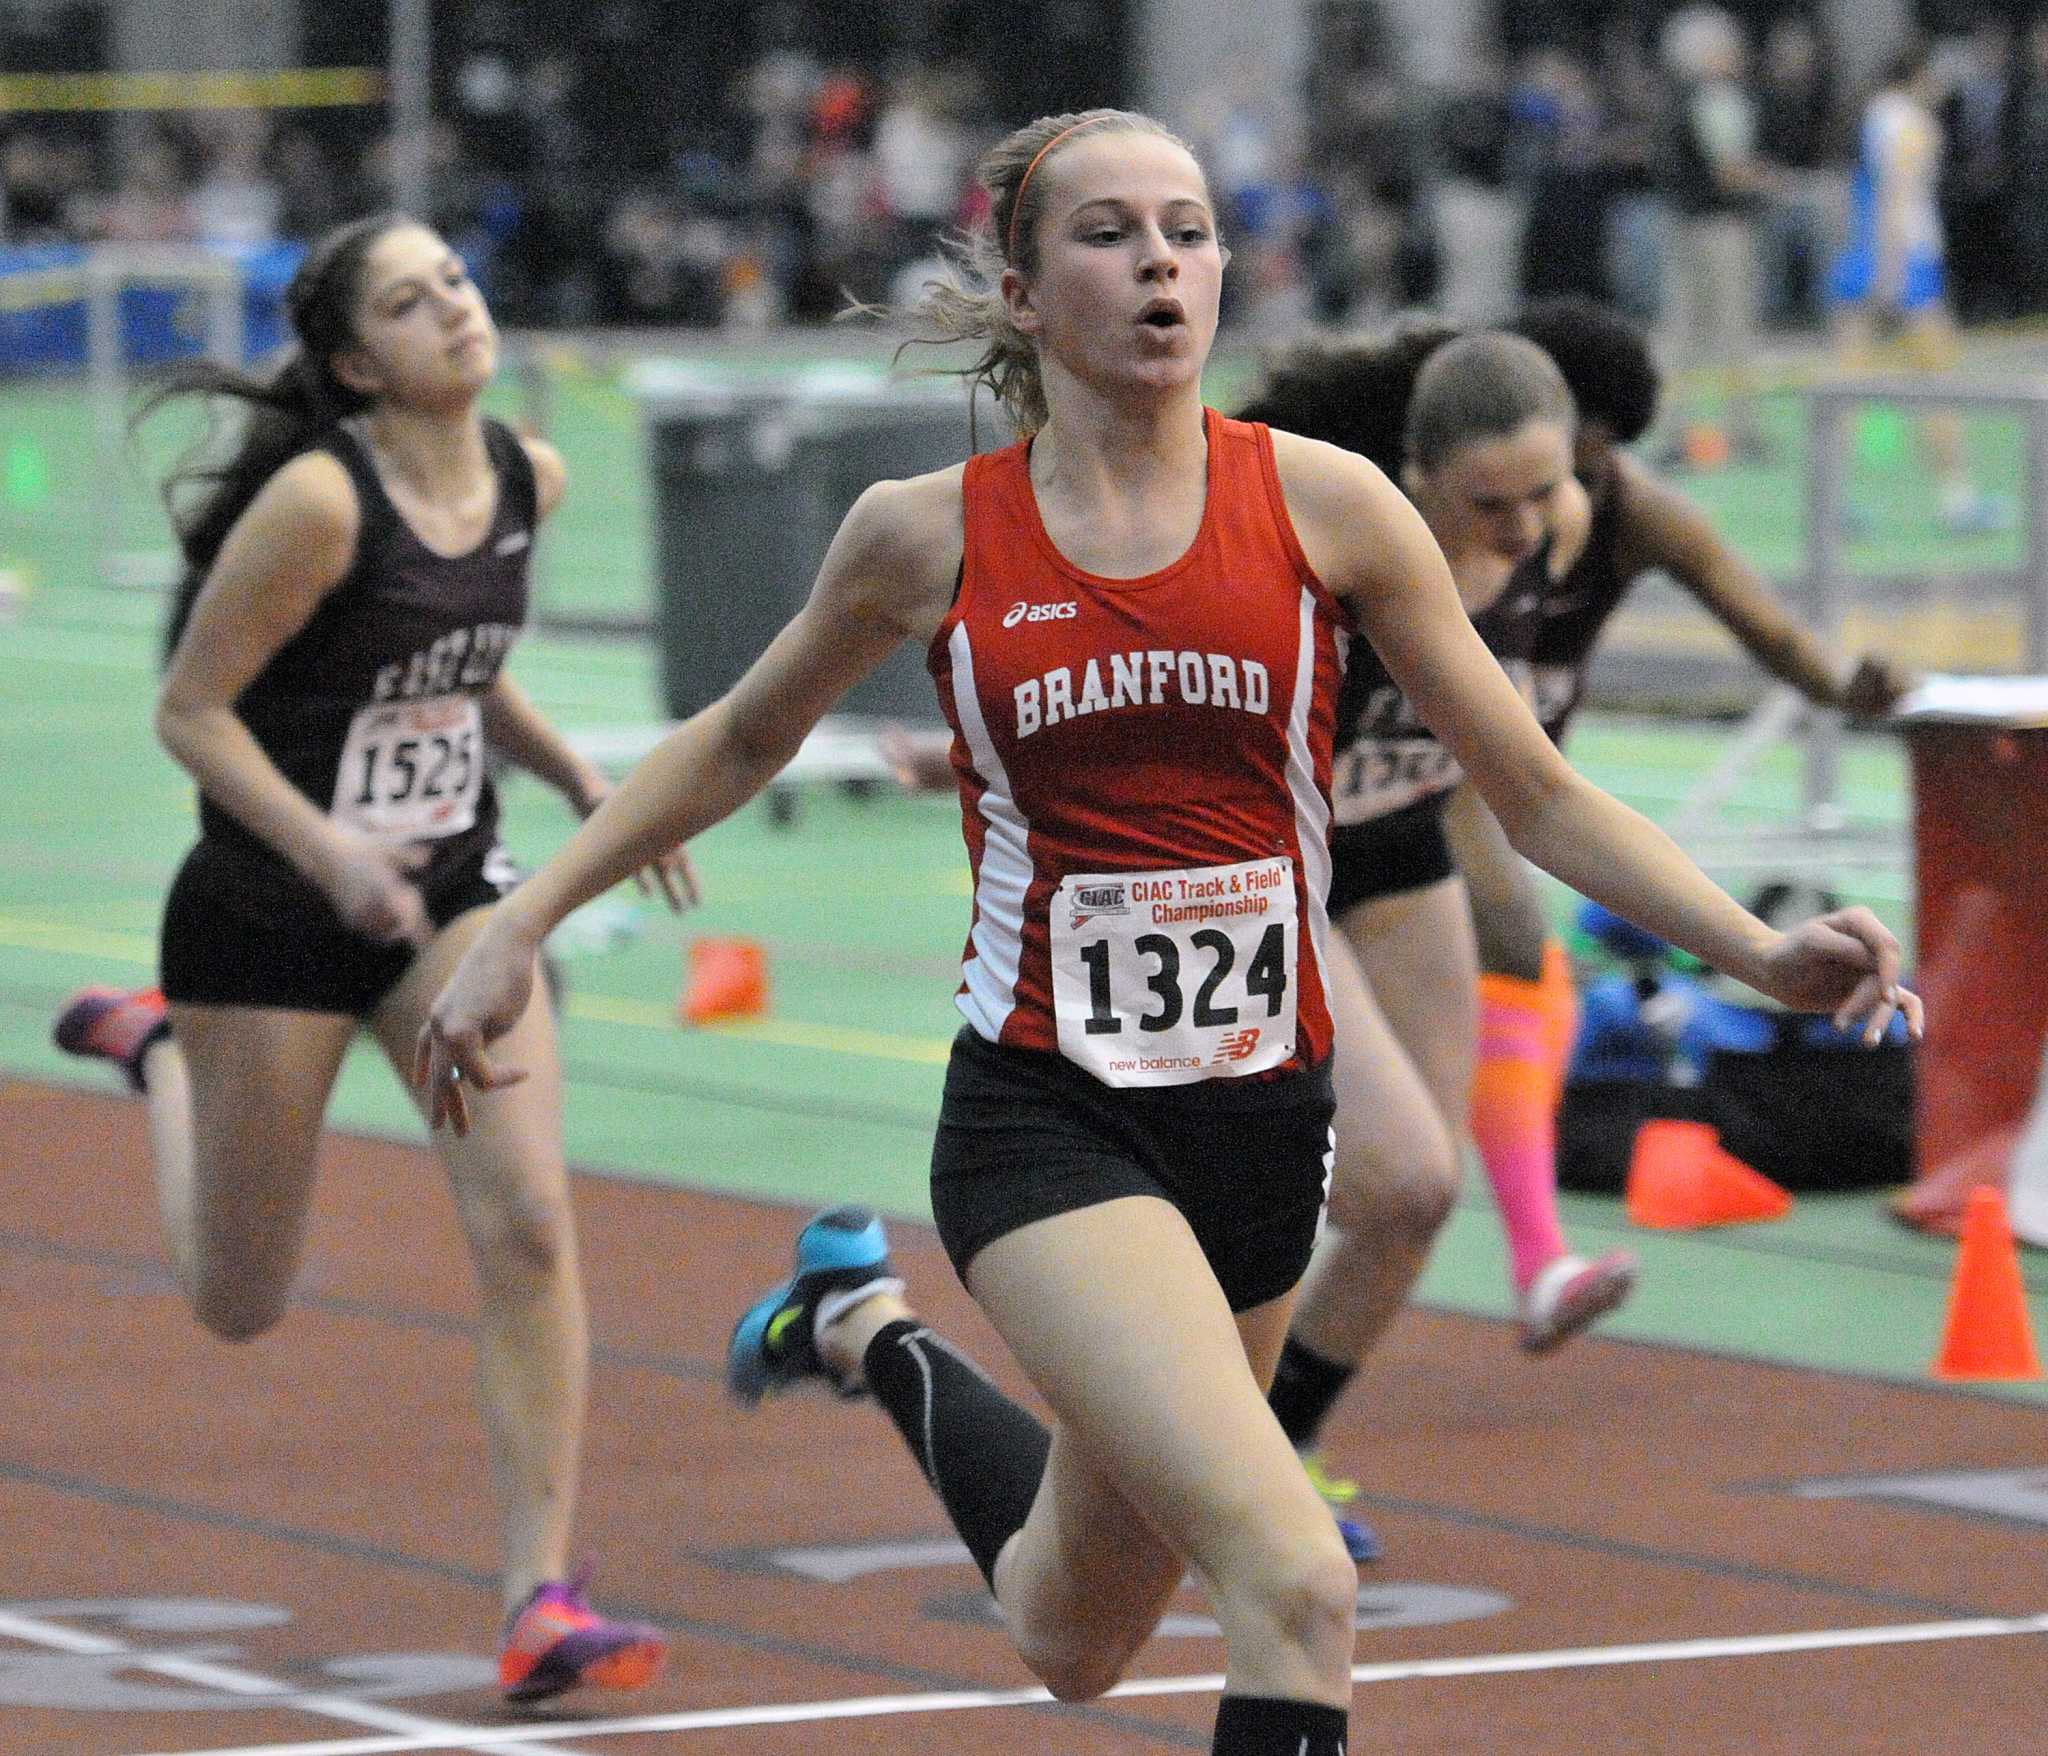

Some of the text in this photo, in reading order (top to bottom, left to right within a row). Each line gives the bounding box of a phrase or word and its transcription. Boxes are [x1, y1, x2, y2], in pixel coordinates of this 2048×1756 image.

[1026, 601, 1077, 623] asics
[1013, 650, 1269, 739] BRANFORD
[1132, 868, 1281, 903] CIAC Track & Field
[1152, 894, 1268, 924] Championship
[1080, 923, 1287, 1035] 1324
[1109, 1056, 1201, 1071] new balance
